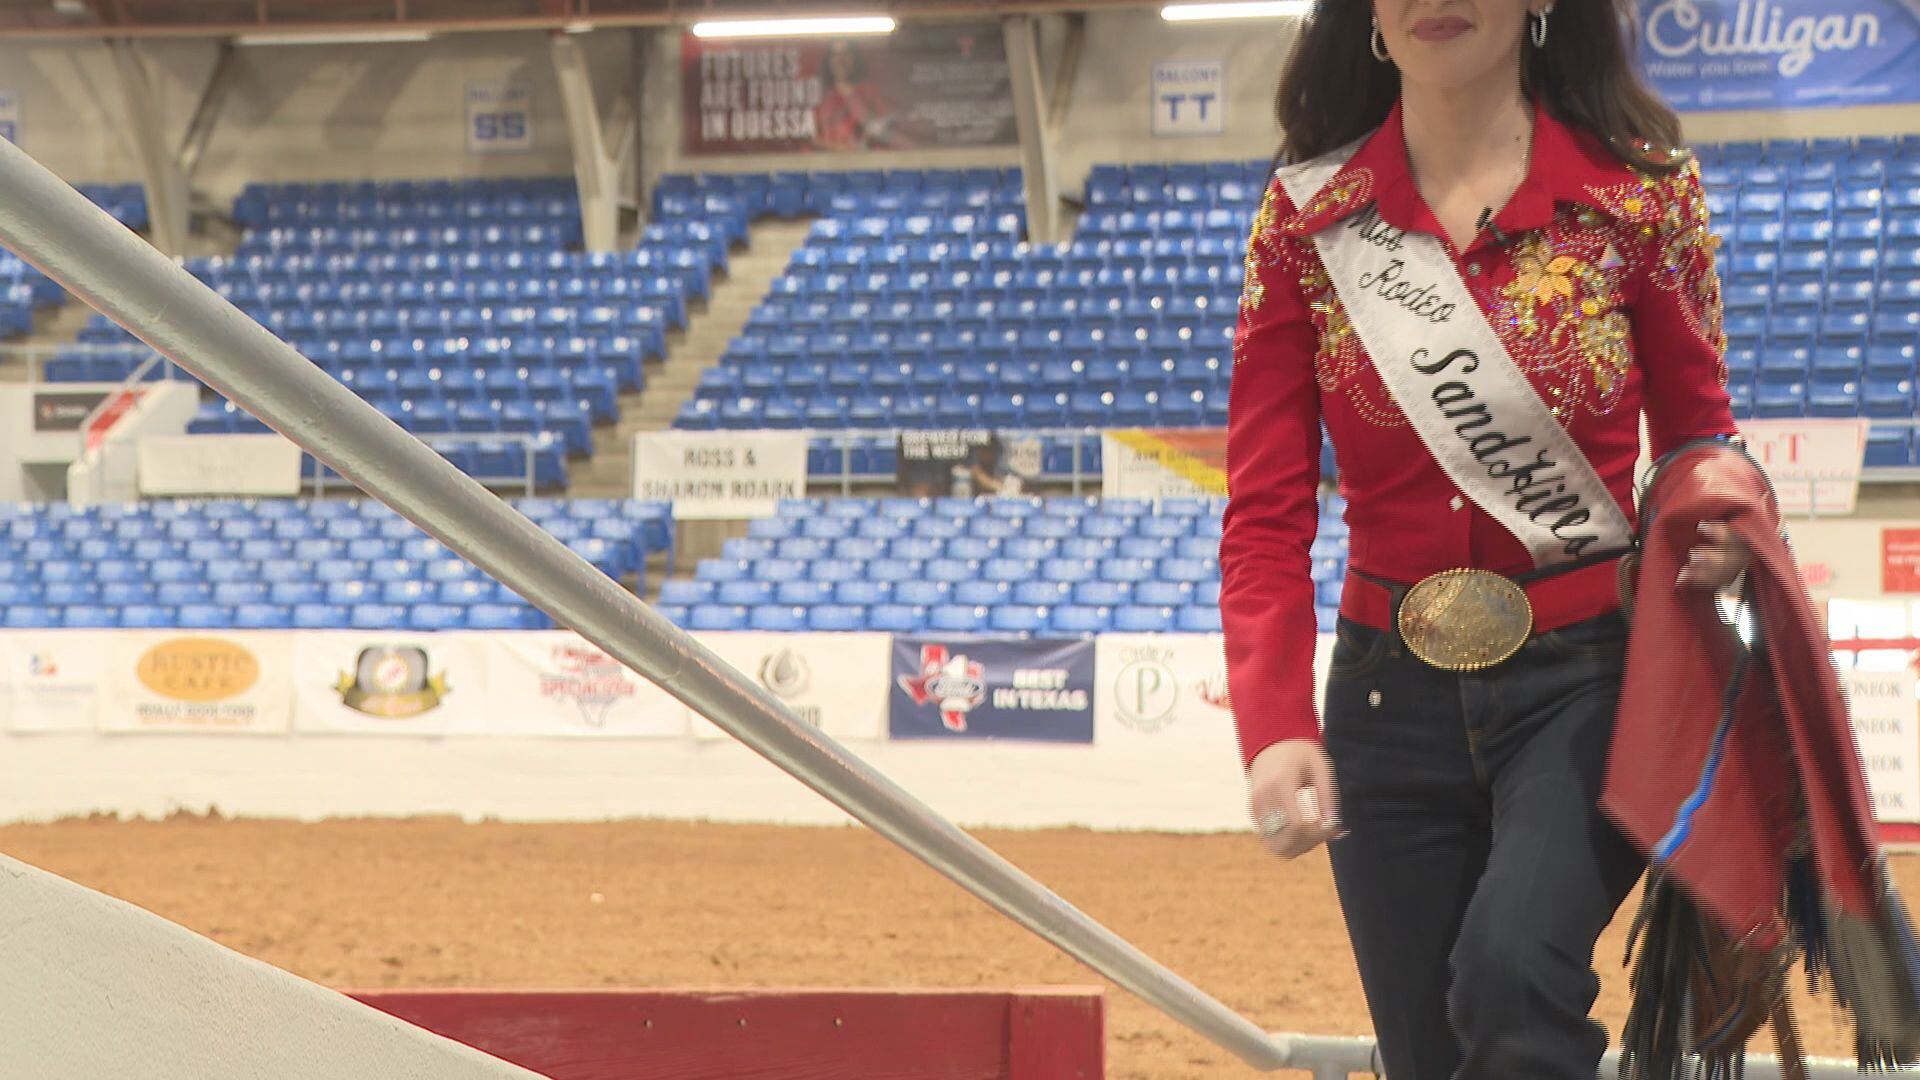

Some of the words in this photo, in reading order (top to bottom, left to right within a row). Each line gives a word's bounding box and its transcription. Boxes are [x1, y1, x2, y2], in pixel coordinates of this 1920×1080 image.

[1646, 0, 1881, 77] Culligan
[701, 49, 799, 79] FUTURES
[701, 80, 741, 109] ARE
[748, 78, 822, 107] FOUND
[1160, 93, 1216, 122] TT
[474, 113, 525, 141] SS
[702, 111, 726, 141] IN
[1358, 257, 1456, 324] Rodeo
[684, 449, 734, 468] ROSS
[743, 449, 756, 467] &
[642, 480, 723, 499] SHARON
[731, 479, 795, 499] ROARK
[1013, 668, 1069, 689] BEST
[993, 691, 1013, 711] IN
[1015, 689, 1089, 711] TEXAS
[1855, 719, 1902, 735] NEOK
[1866, 756, 1902, 772] EOK
